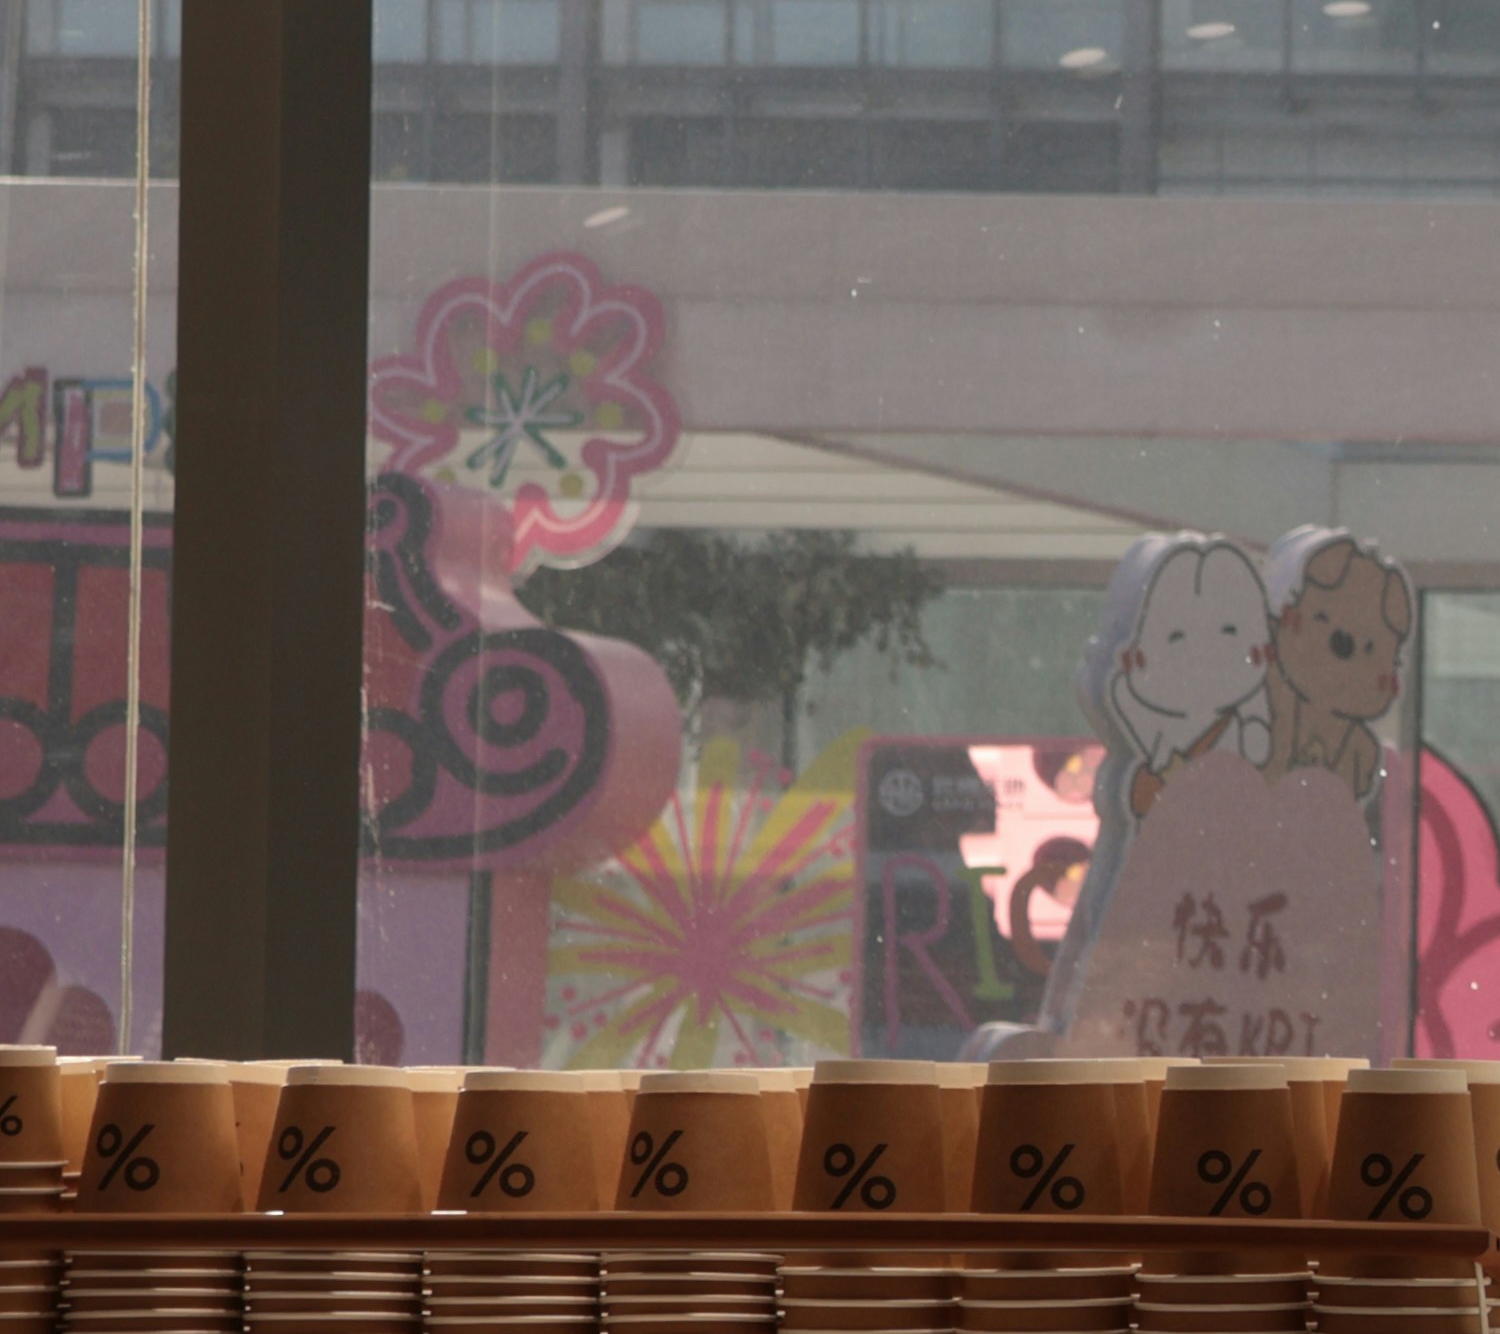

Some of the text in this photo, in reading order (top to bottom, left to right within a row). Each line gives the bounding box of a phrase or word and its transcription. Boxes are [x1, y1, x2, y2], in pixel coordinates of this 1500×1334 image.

[1173, 891, 1288, 980] 快乐
[97, 1124, 160, 1192] %
[278, 1126, 341, 1194] %
[465, 1131, 536, 1198] %
[630, 1130, 689, 1198] %
[823, 1143, 897, 1210] %
[1009, 1144, 1086, 1212] %
[1197, 1149, 1272, 1217] %
[1360, 1153, 1433, 1221] %
